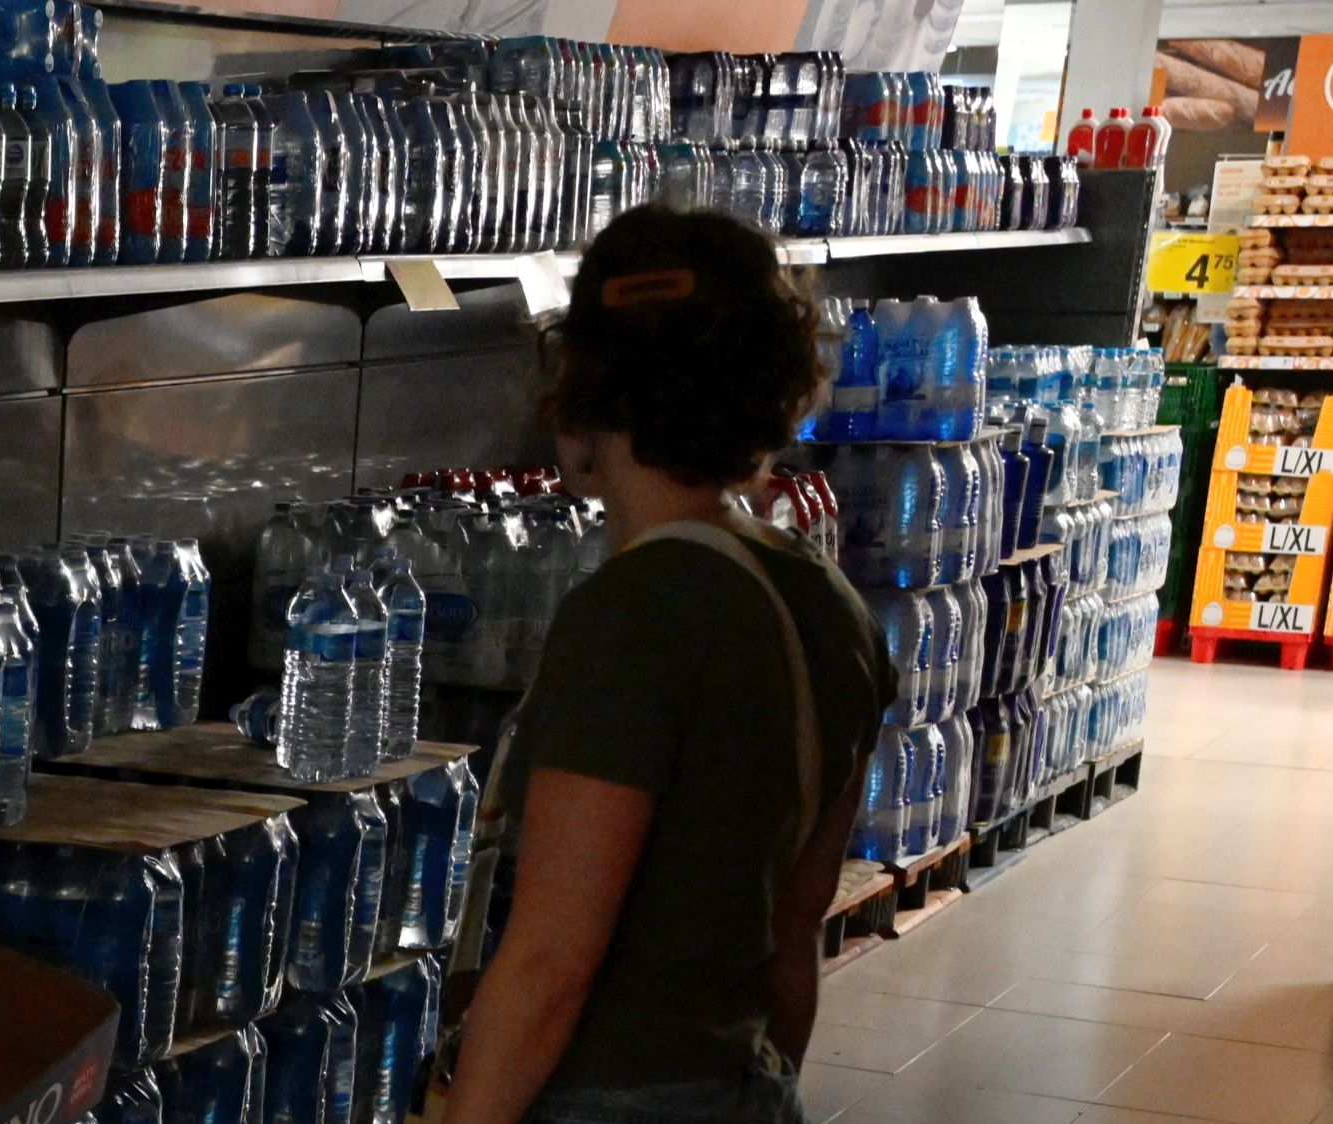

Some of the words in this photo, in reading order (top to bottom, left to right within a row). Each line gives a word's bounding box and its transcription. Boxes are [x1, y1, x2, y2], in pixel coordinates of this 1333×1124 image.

[1185, 254, 1210, 289] 4
[1214, 254, 1234, 270] 75
[1269, 526, 1316, 552] L/XL
[1257, 604, 1304, 631] L/XL
